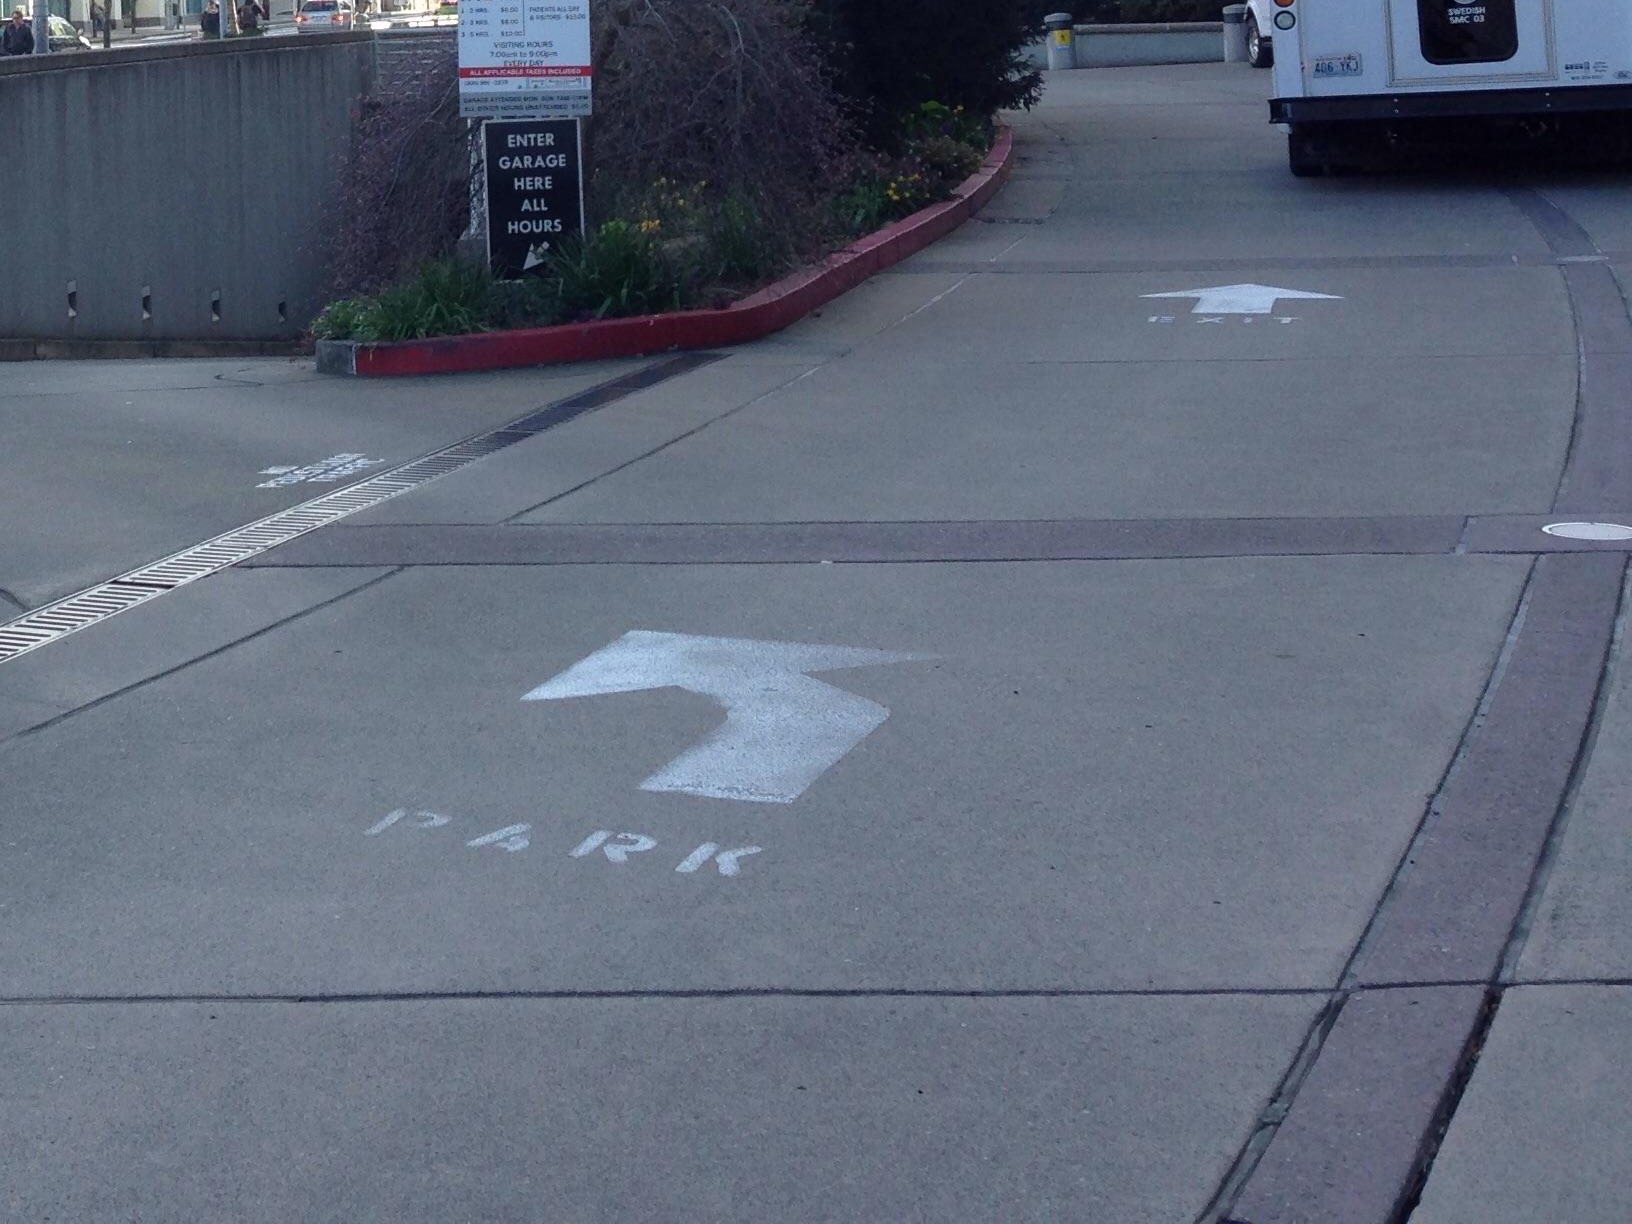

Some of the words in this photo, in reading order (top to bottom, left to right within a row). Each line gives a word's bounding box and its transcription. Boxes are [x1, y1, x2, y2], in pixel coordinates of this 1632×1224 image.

[1448, 6, 1486, 16] SWEDISH
[1473, 14, 1485, 23] 03
[507, 132, 555, 148] ENTER
[498, 154, 567, 170] GARAGE
[514, 176, 553, 190] HERE
[521, 198, 548, 212] ALL
[507, 219, 563, 234] HOURS
[364, 808, 763, 876] PARK
